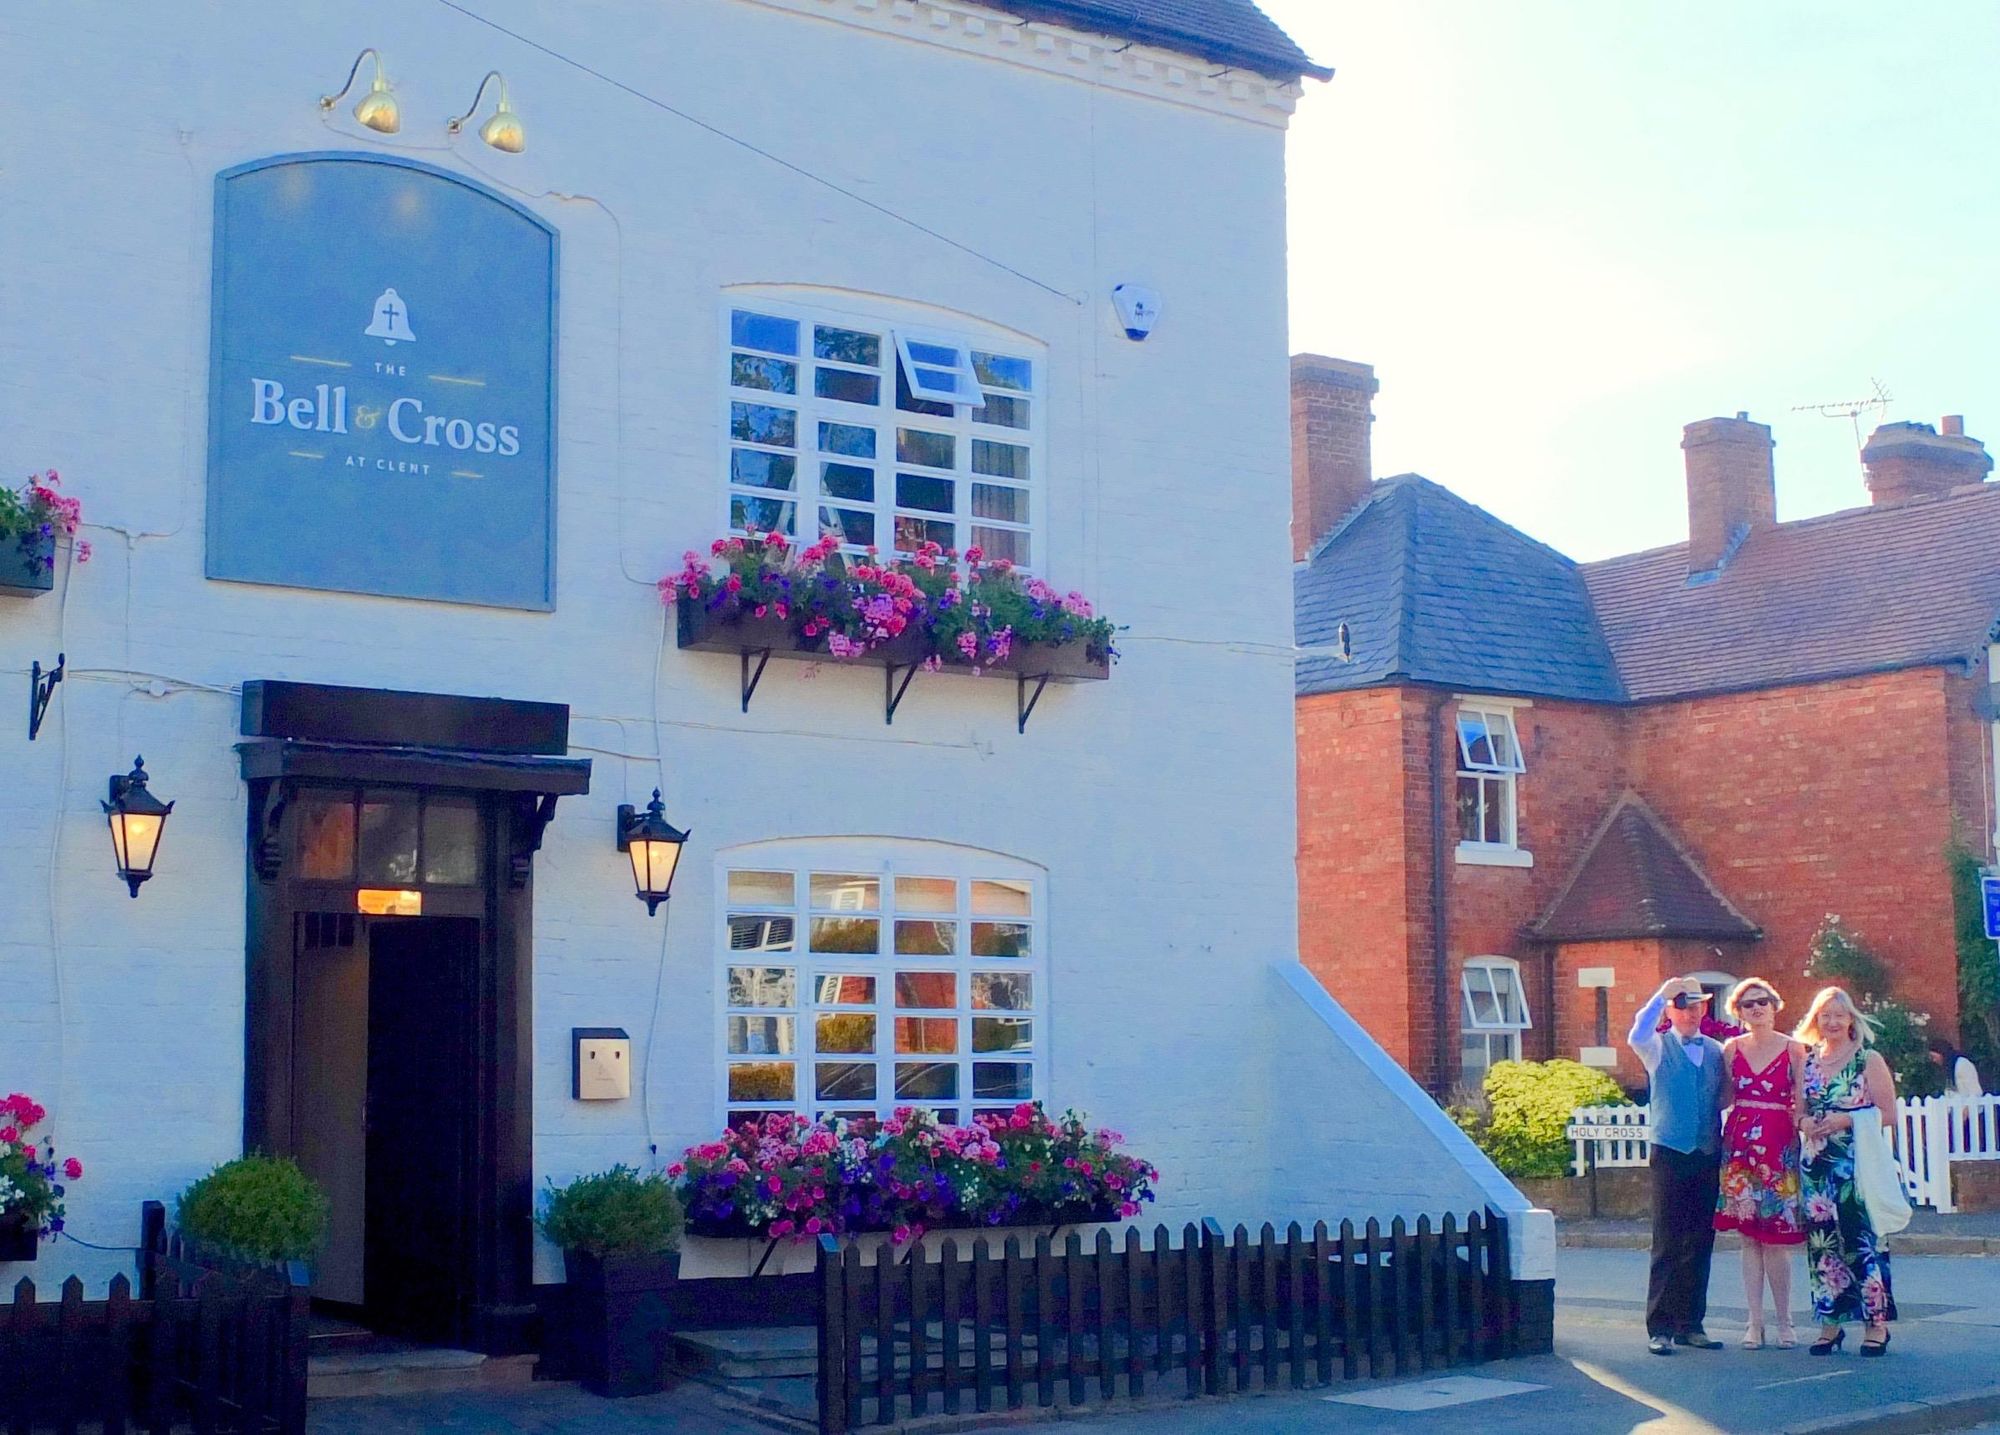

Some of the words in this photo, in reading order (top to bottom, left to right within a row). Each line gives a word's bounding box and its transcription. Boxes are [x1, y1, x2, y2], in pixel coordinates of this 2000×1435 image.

[375, 362, 406, 376] THE
[251, 378, 348, 434] Bell
[355, 405, 380, 429] &
[388, 398, 520, 456] Cross
[345, 455, 366, 469] AT
[377, 459, 430, 475] CLENT
[1571, 1127, 1599, 1138] HOLY
[1605, 1127, 1643, 1138] CROSS
